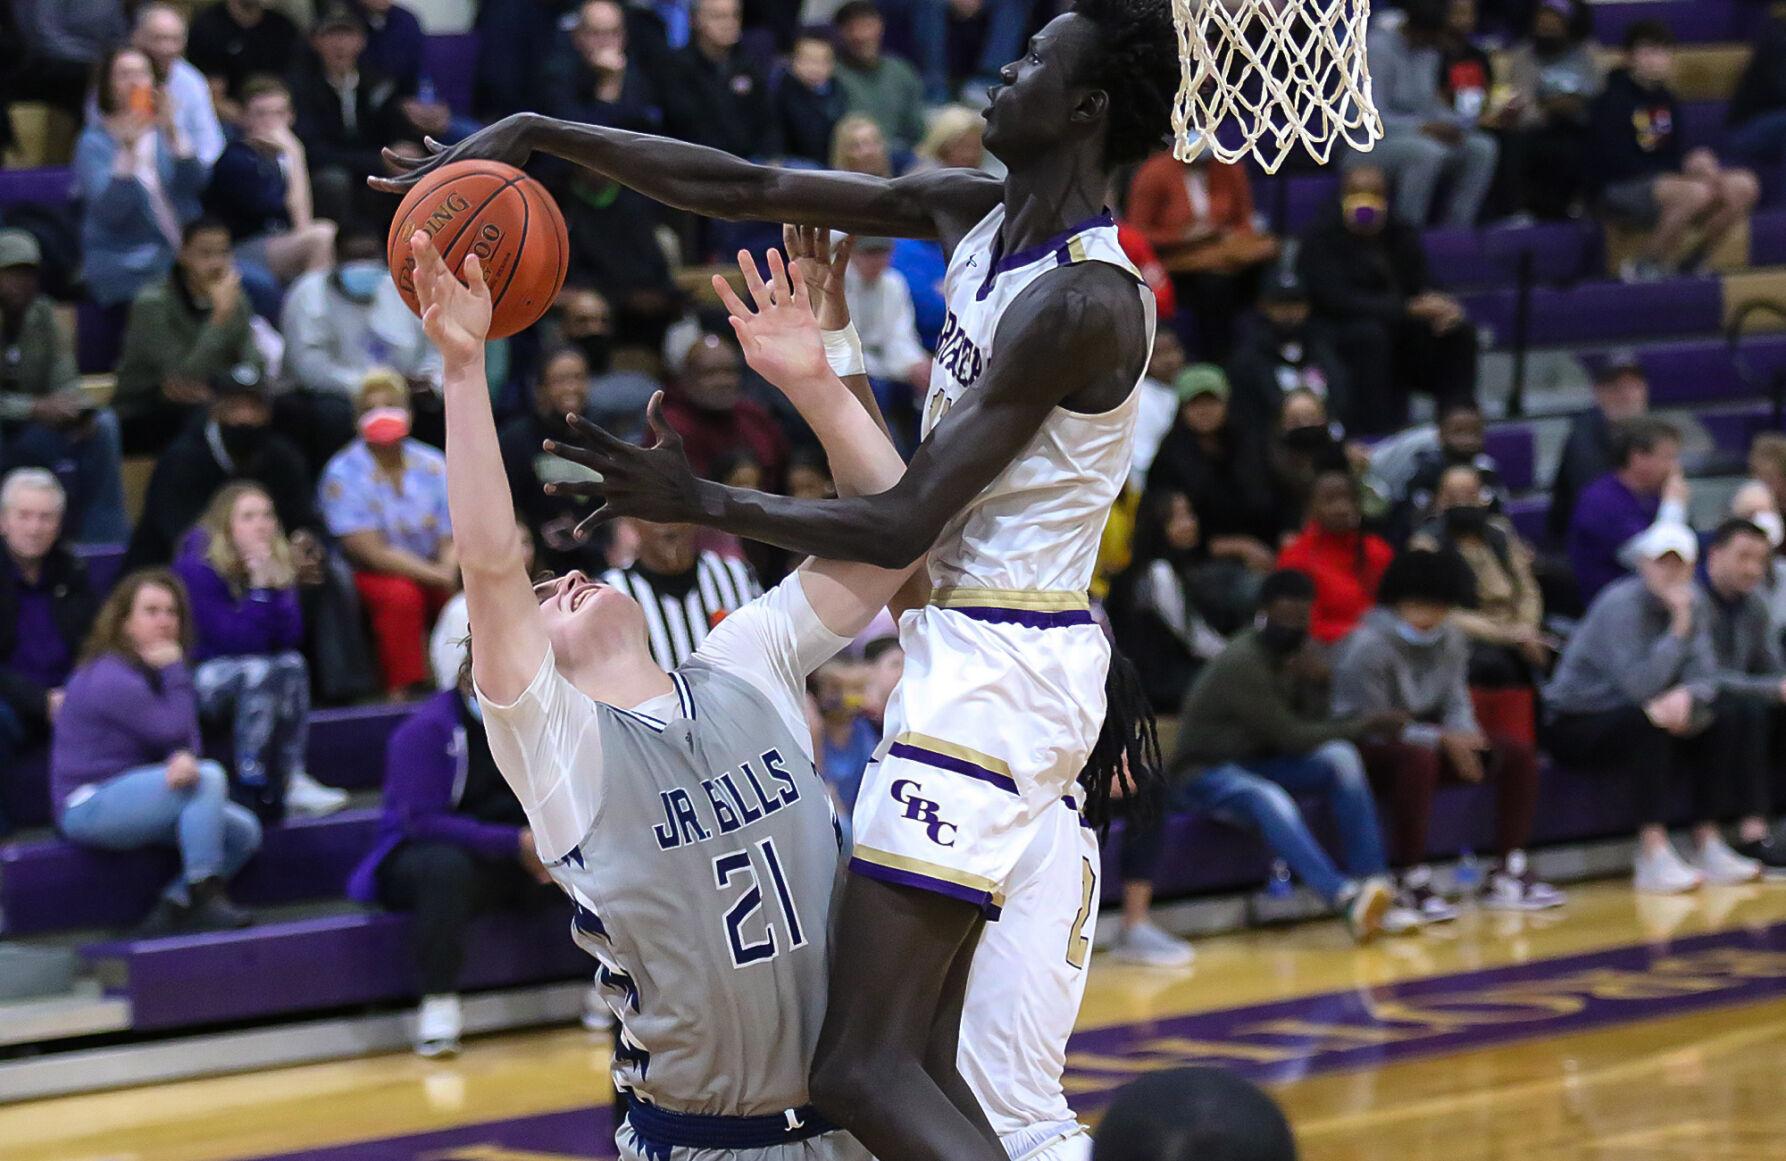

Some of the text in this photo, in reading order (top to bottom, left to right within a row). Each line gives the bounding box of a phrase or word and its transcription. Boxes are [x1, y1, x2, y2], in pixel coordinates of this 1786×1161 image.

[651, 747, 801, 851] JR. BLLS
[890, 779, 958, 848] CBC
[711, 836, 808, 969] 21
